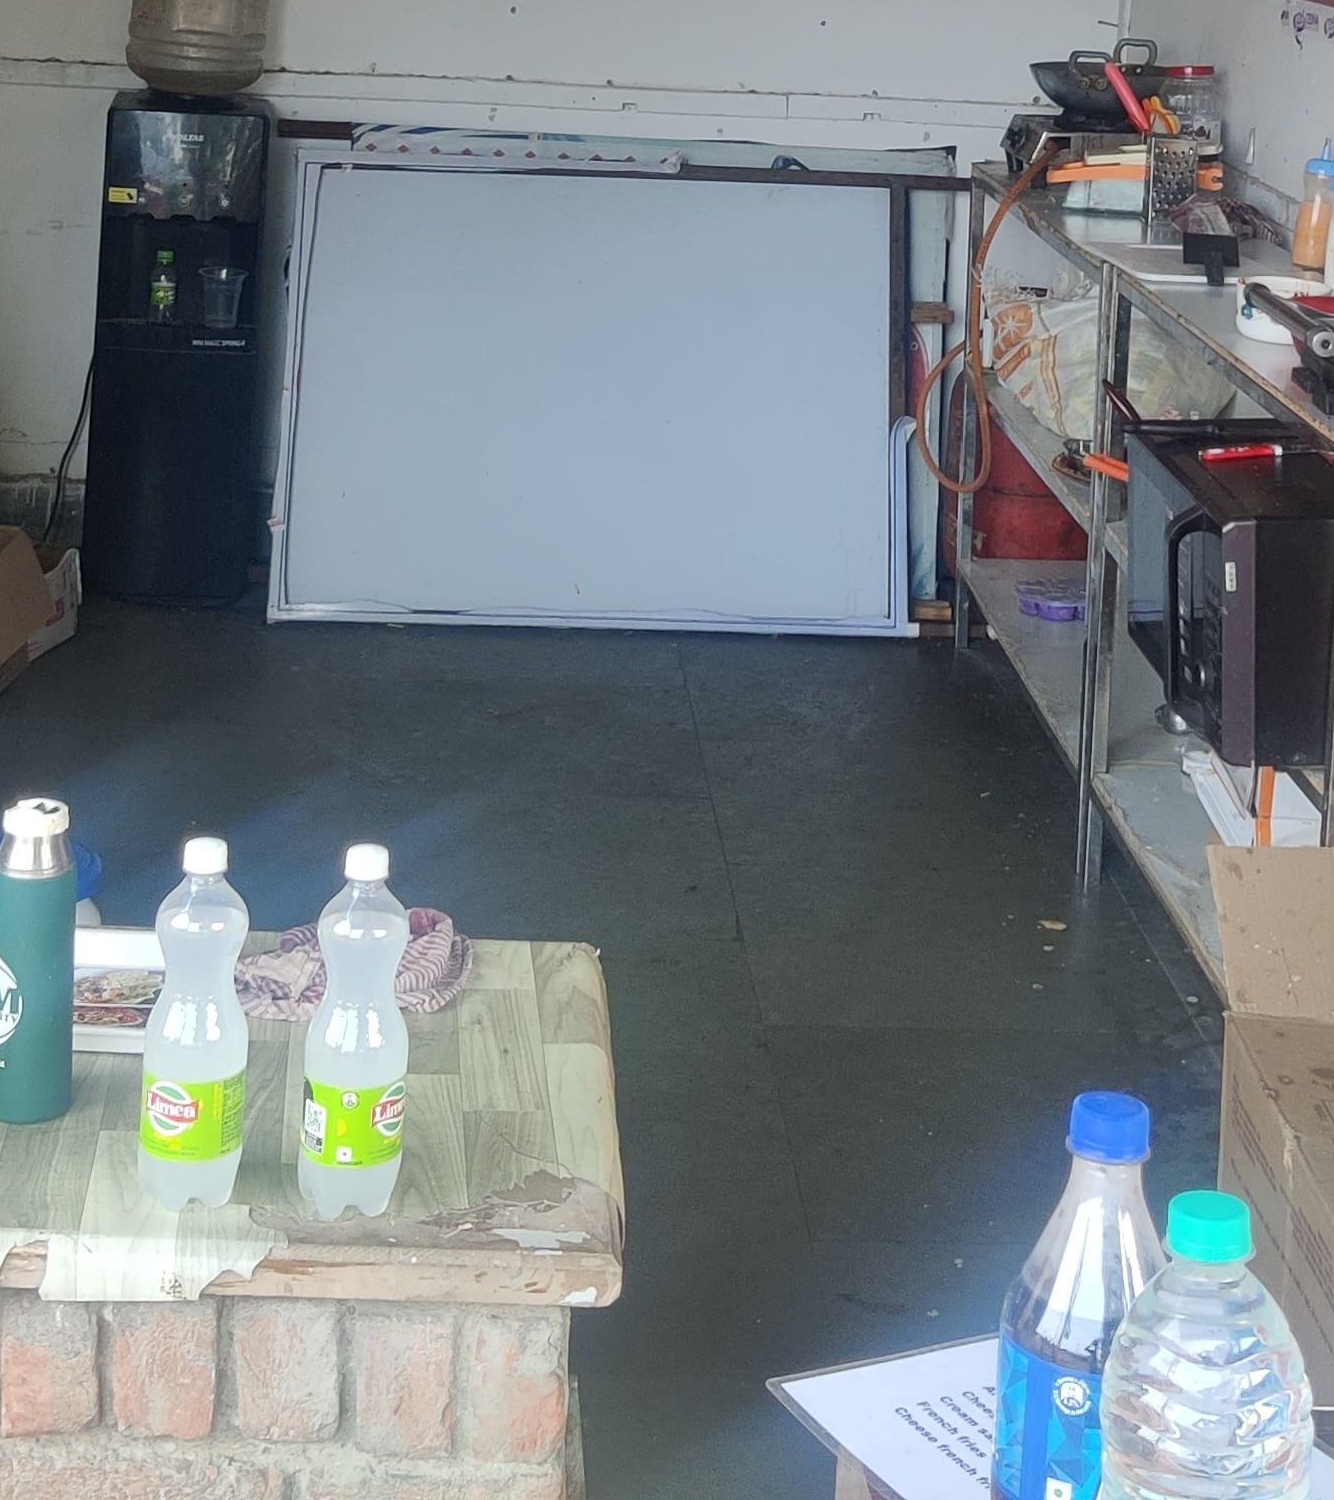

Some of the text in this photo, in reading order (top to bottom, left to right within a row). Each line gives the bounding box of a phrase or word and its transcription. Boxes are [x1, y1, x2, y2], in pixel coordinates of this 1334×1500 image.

[147, 1092, 196, 1118] Limca
[373, 1098, 405, 1122] Lim
[940, 1396, 979, 1428] Cream
[895, 1406, 939, 1443] Cheese
[937, 1443, 978, 1476] french
[916, 1400, 959, 1436] French
[957, 1436, 987, 1459] fries
